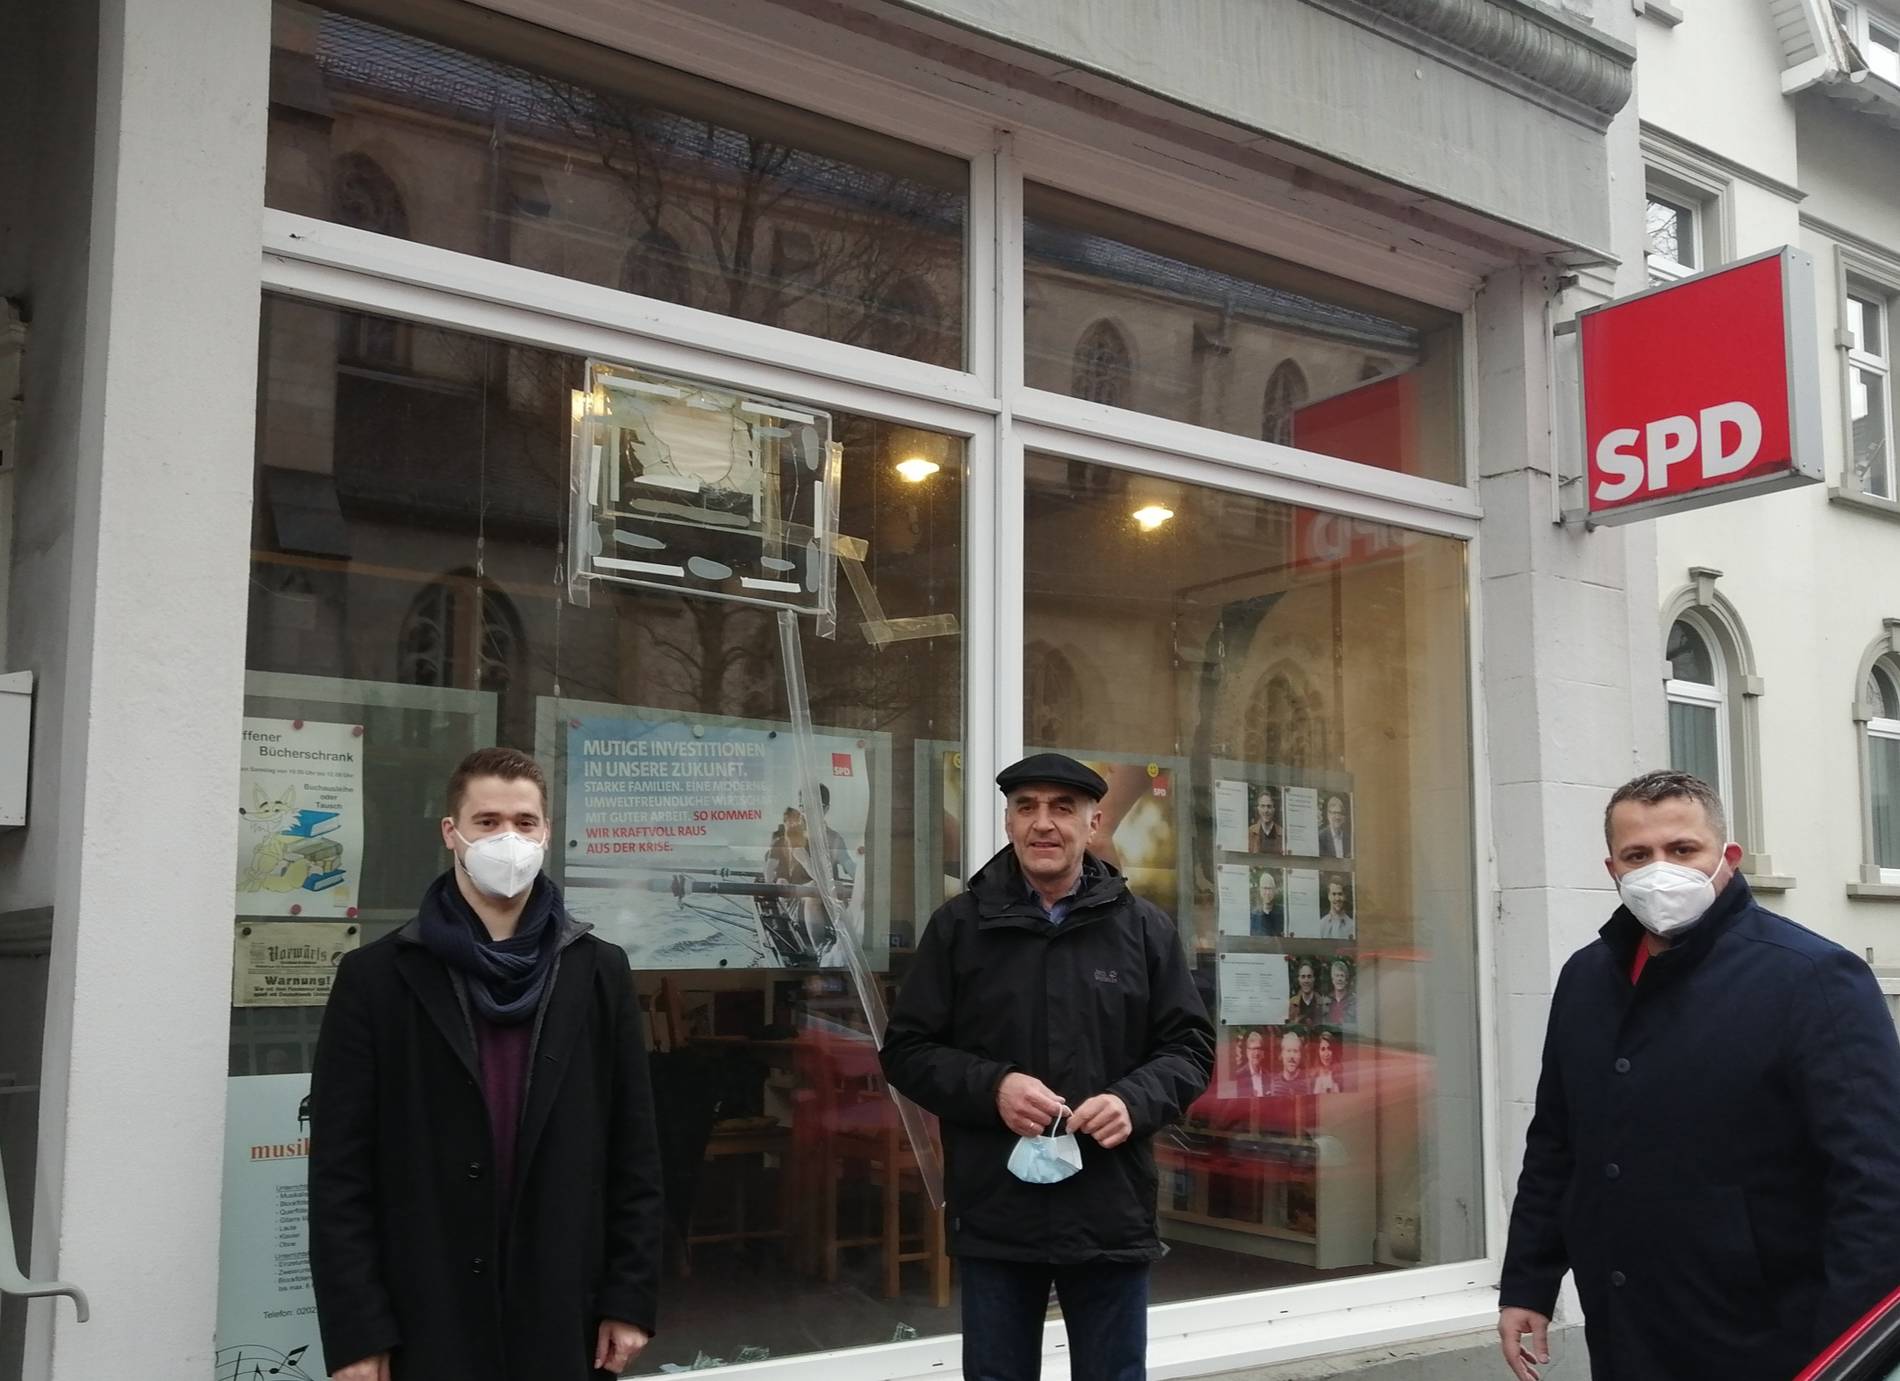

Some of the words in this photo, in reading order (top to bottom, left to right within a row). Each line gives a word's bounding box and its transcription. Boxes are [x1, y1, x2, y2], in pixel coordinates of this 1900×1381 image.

[1594, 401, 1763, 501] SPD
[242, 730, 283, 742] ffener
[259, 746, 354, 763] Bücherschrank
[583, 740, 648, 756] MUTIGE
[651, 741, 765, 757] INVESTITIONEN
[584, 762, 602, 777] IN
[606, 762, 668, 777] UNSERE
[672, 762, 748, 777] ZUKUNFT.
[584, 781, 626, 792] STARKE
[628, 781, 684, 792] FAMILIEN.
[686, 781, 711, 791] EINE
[585, 795, 711, 808] UMWELTFREUNDLICHE
[586, 811, 607, 824] MIT
[610, 811, 648, 823] GUTER
[649, 810, 691, 823] ARBEIT.
[693, 810, 709, 822] SO
[711, 809, 763, 821] KOMMEN
[586, 827, 609, 838] WIR
[612, 826, 677, 838] KRAFTVOLL
[678, 825, 707, 837] RAUS
[587, 842, 610, 854] AUS
[613, 842, 636, 853] DER
[639, 841, 673, 852] KRISE.
[264, 976, 331, 986] Warnung!
